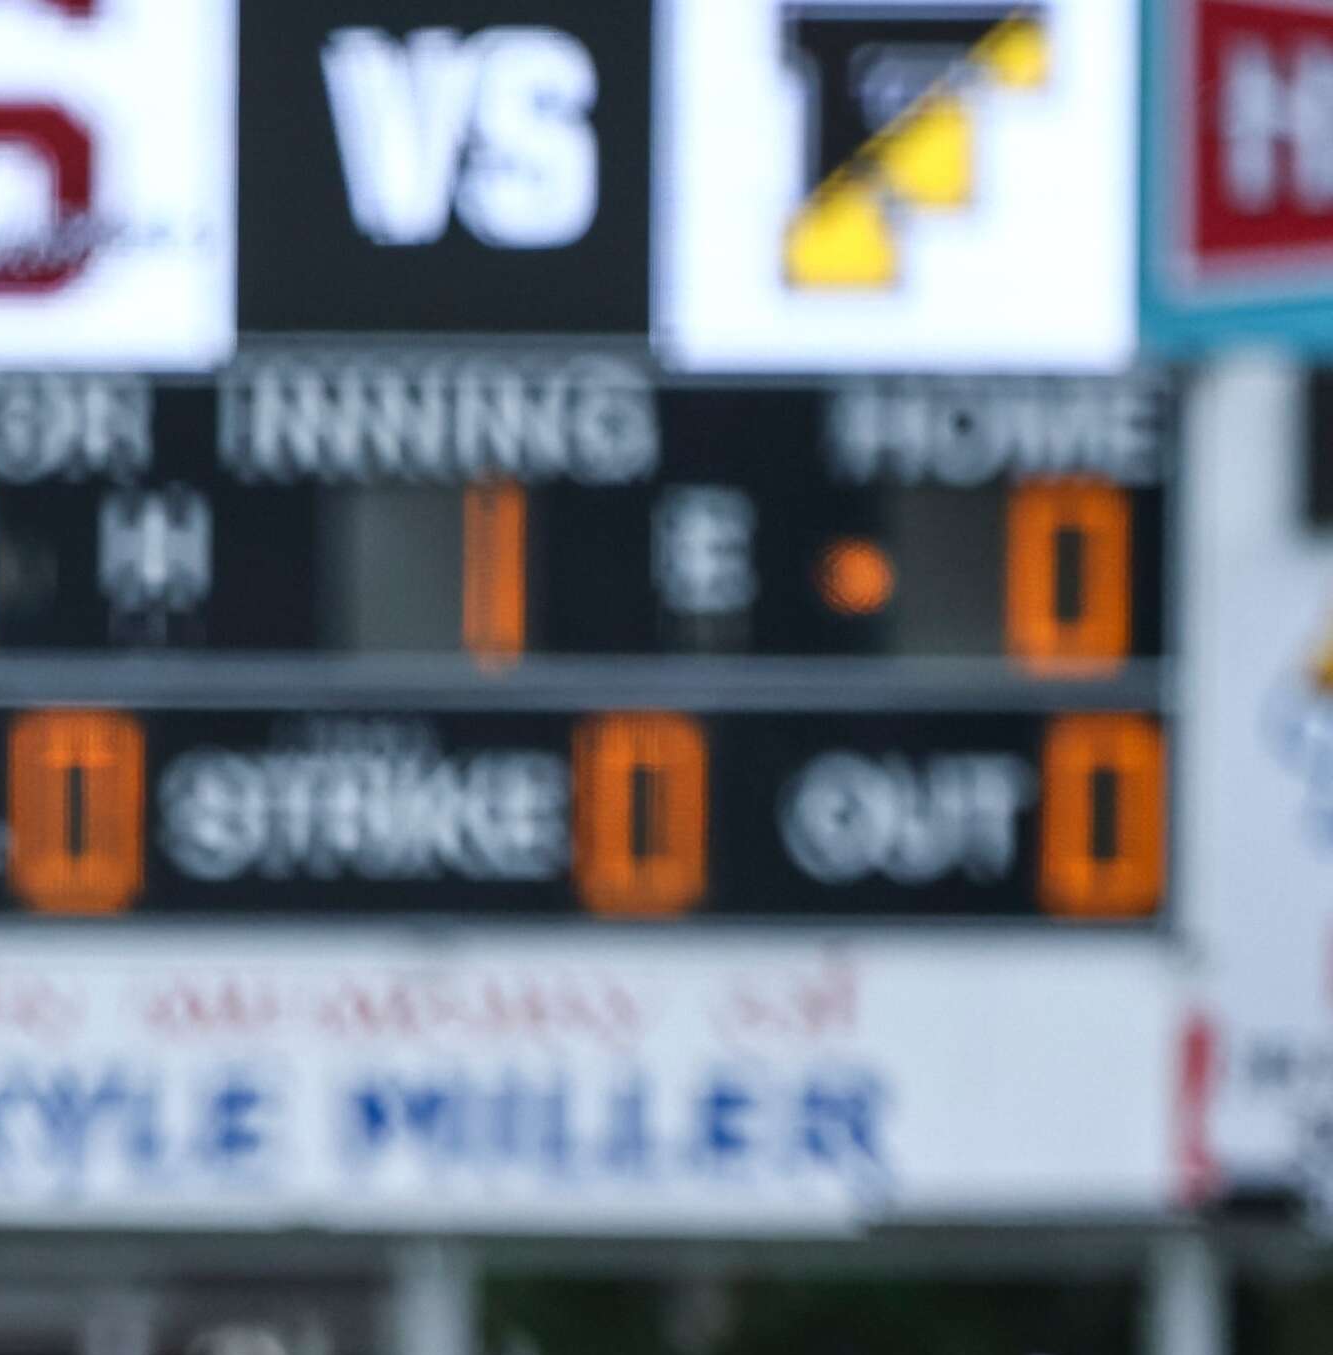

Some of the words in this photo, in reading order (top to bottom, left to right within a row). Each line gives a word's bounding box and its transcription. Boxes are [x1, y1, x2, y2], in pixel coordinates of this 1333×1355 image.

[319, 24, 598, 249] VS
[217, 357, 659, 484] INNING
[821, 378, 1161, 486] HOME
[98, 485, 213, 608] H
[651, 485, 755, 612] E
[5, 706, 146, 916] 0
[158, 746, 573, 882] STRIKE
[571, 708, 709, 920] 0
[775, 748, 1039, 886] OUT
[1039, 708, 1168, 922] 0
[341, 1065, 895, 1185] MILLER
